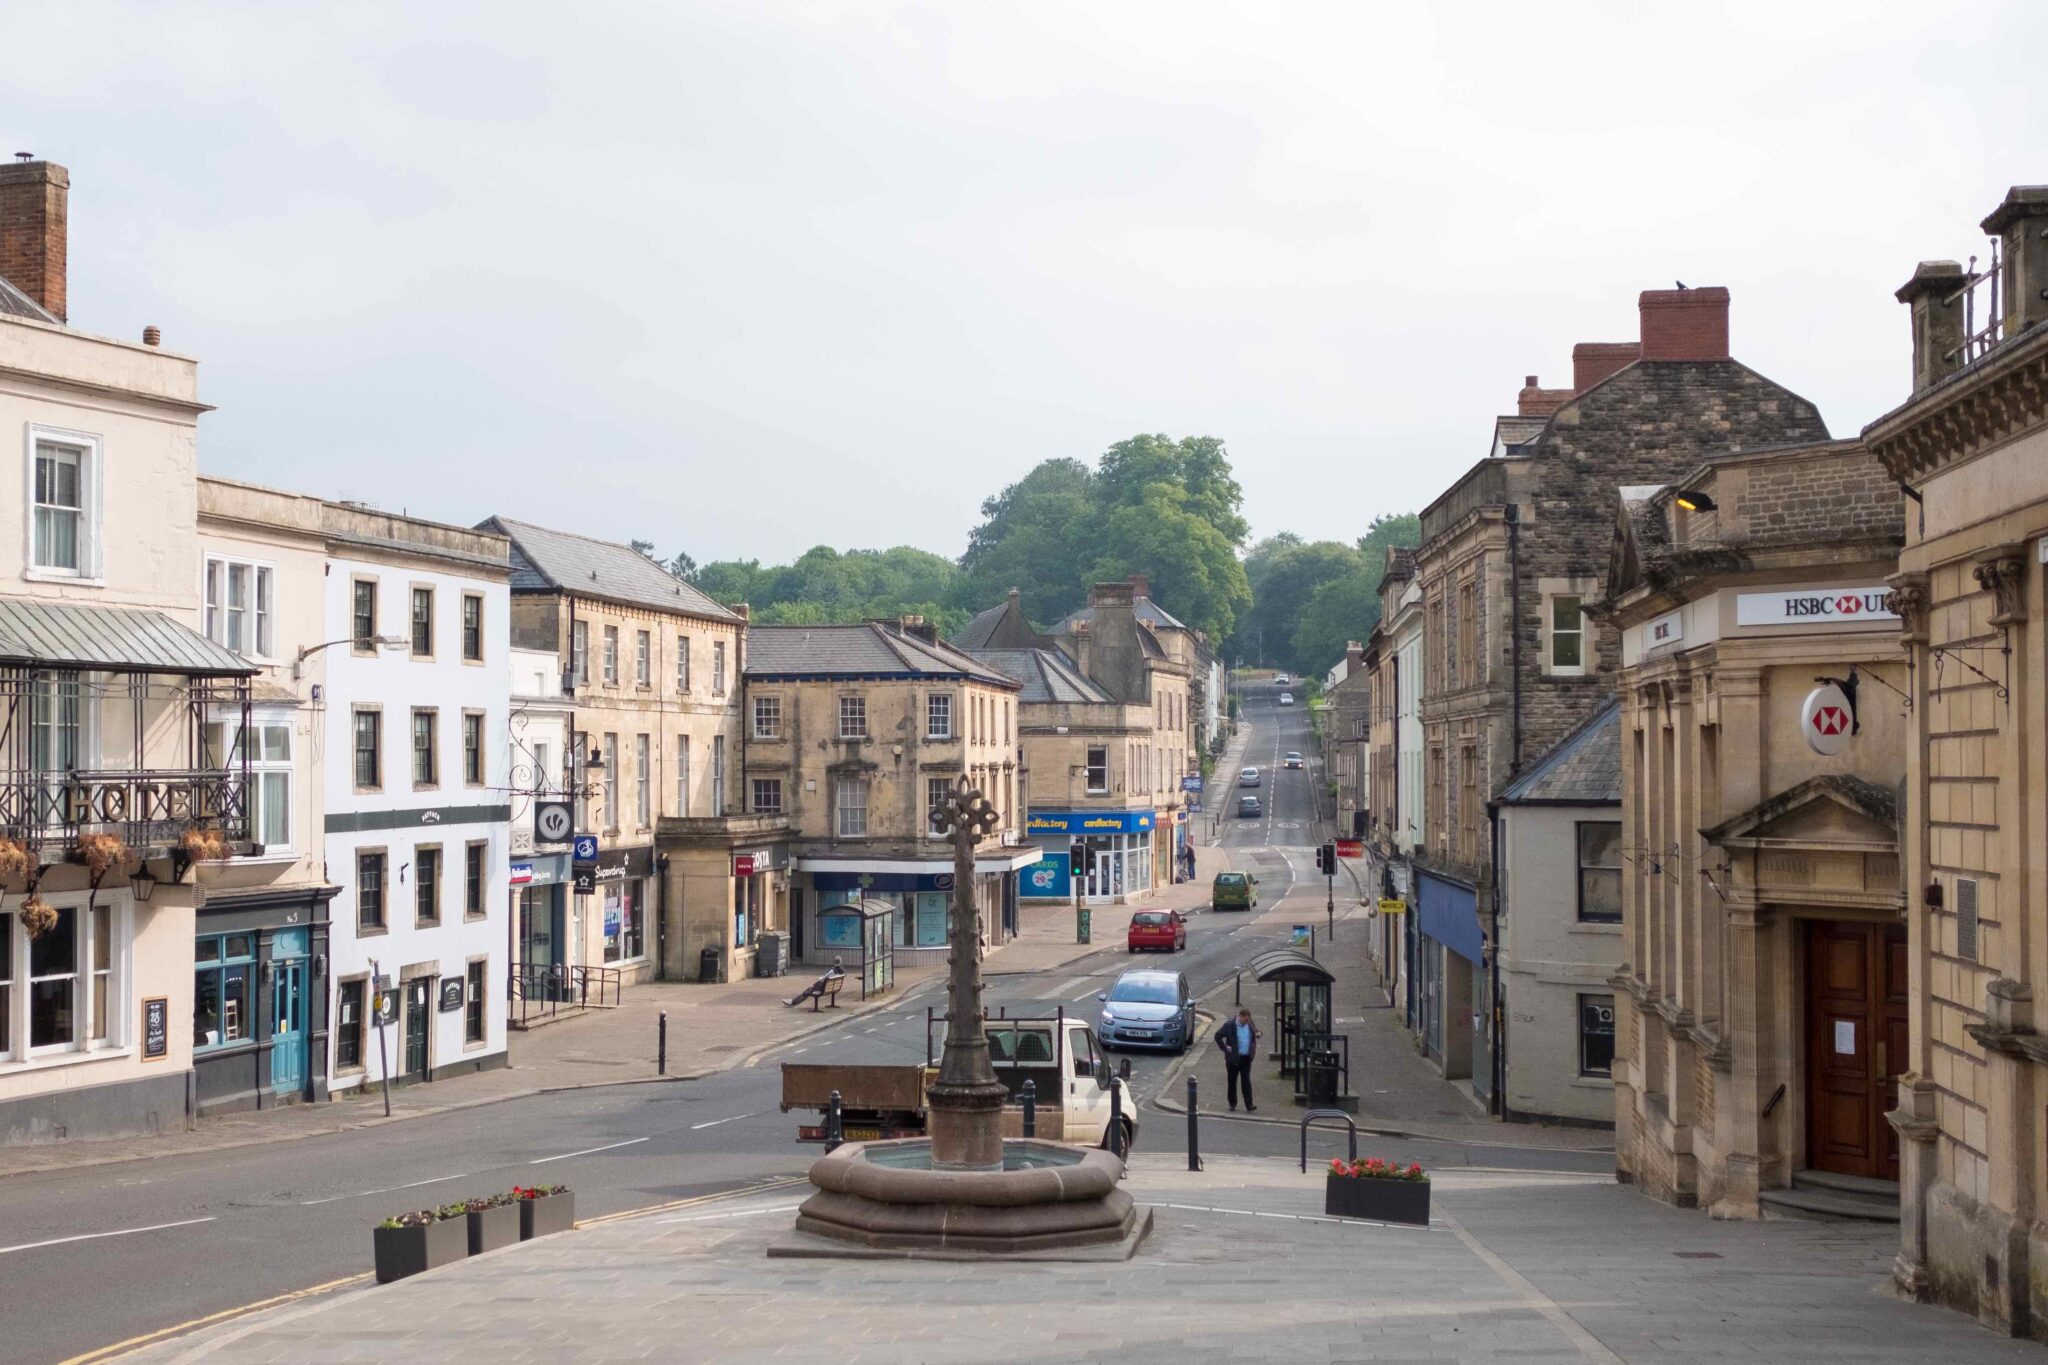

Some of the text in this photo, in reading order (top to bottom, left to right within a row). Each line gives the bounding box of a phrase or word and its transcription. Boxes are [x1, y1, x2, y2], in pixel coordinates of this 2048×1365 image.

[1785, 597, 1834, 616] HSBC
[66, 783, 221, 823] HOTEL
[1026, 818, 1068, 830] ardfactory
[1084, 818, 1122, 829] cardfactory
[595, 865, 626, 879] Superdrug
